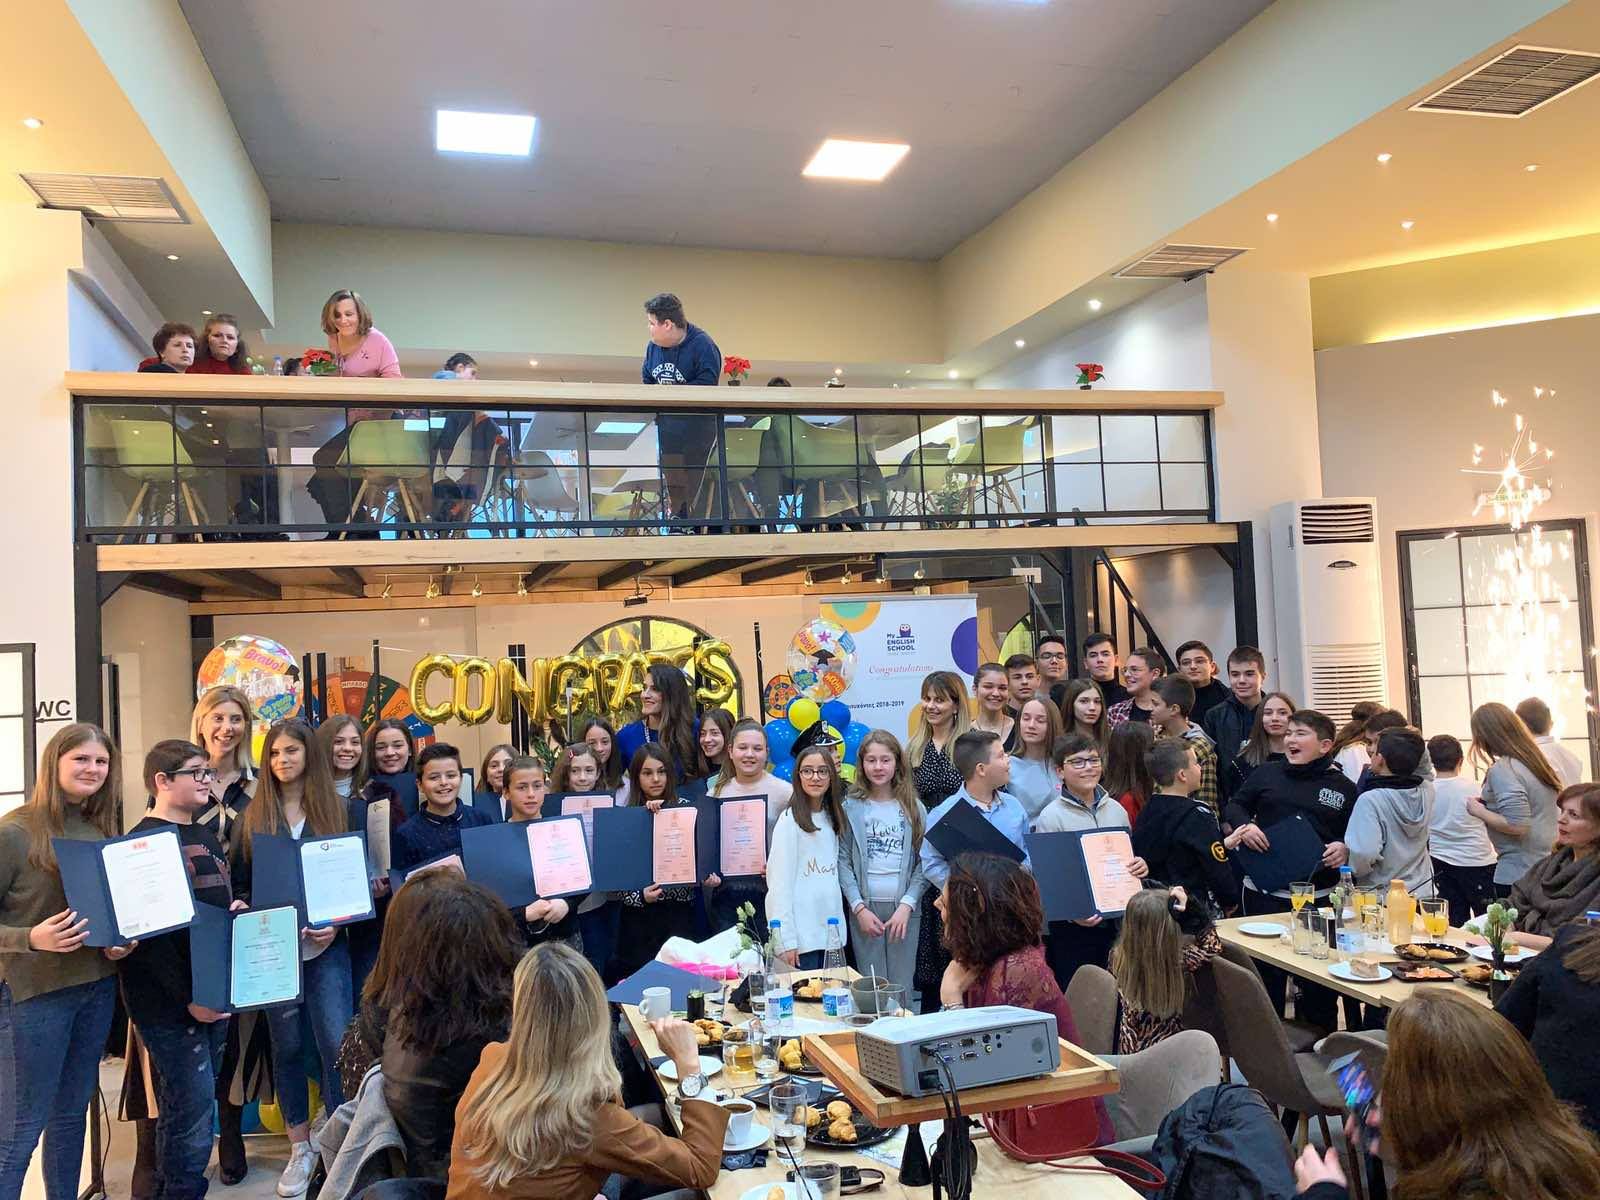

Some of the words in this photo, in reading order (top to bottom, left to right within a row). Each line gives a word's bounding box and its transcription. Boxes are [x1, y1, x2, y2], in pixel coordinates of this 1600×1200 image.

[244, 648, 286, 671] Bravo!
[35, 699, 71, 717] WC
[875, 700, 905, 708] 2018-2019
[866, 818, 899, 838] Love
